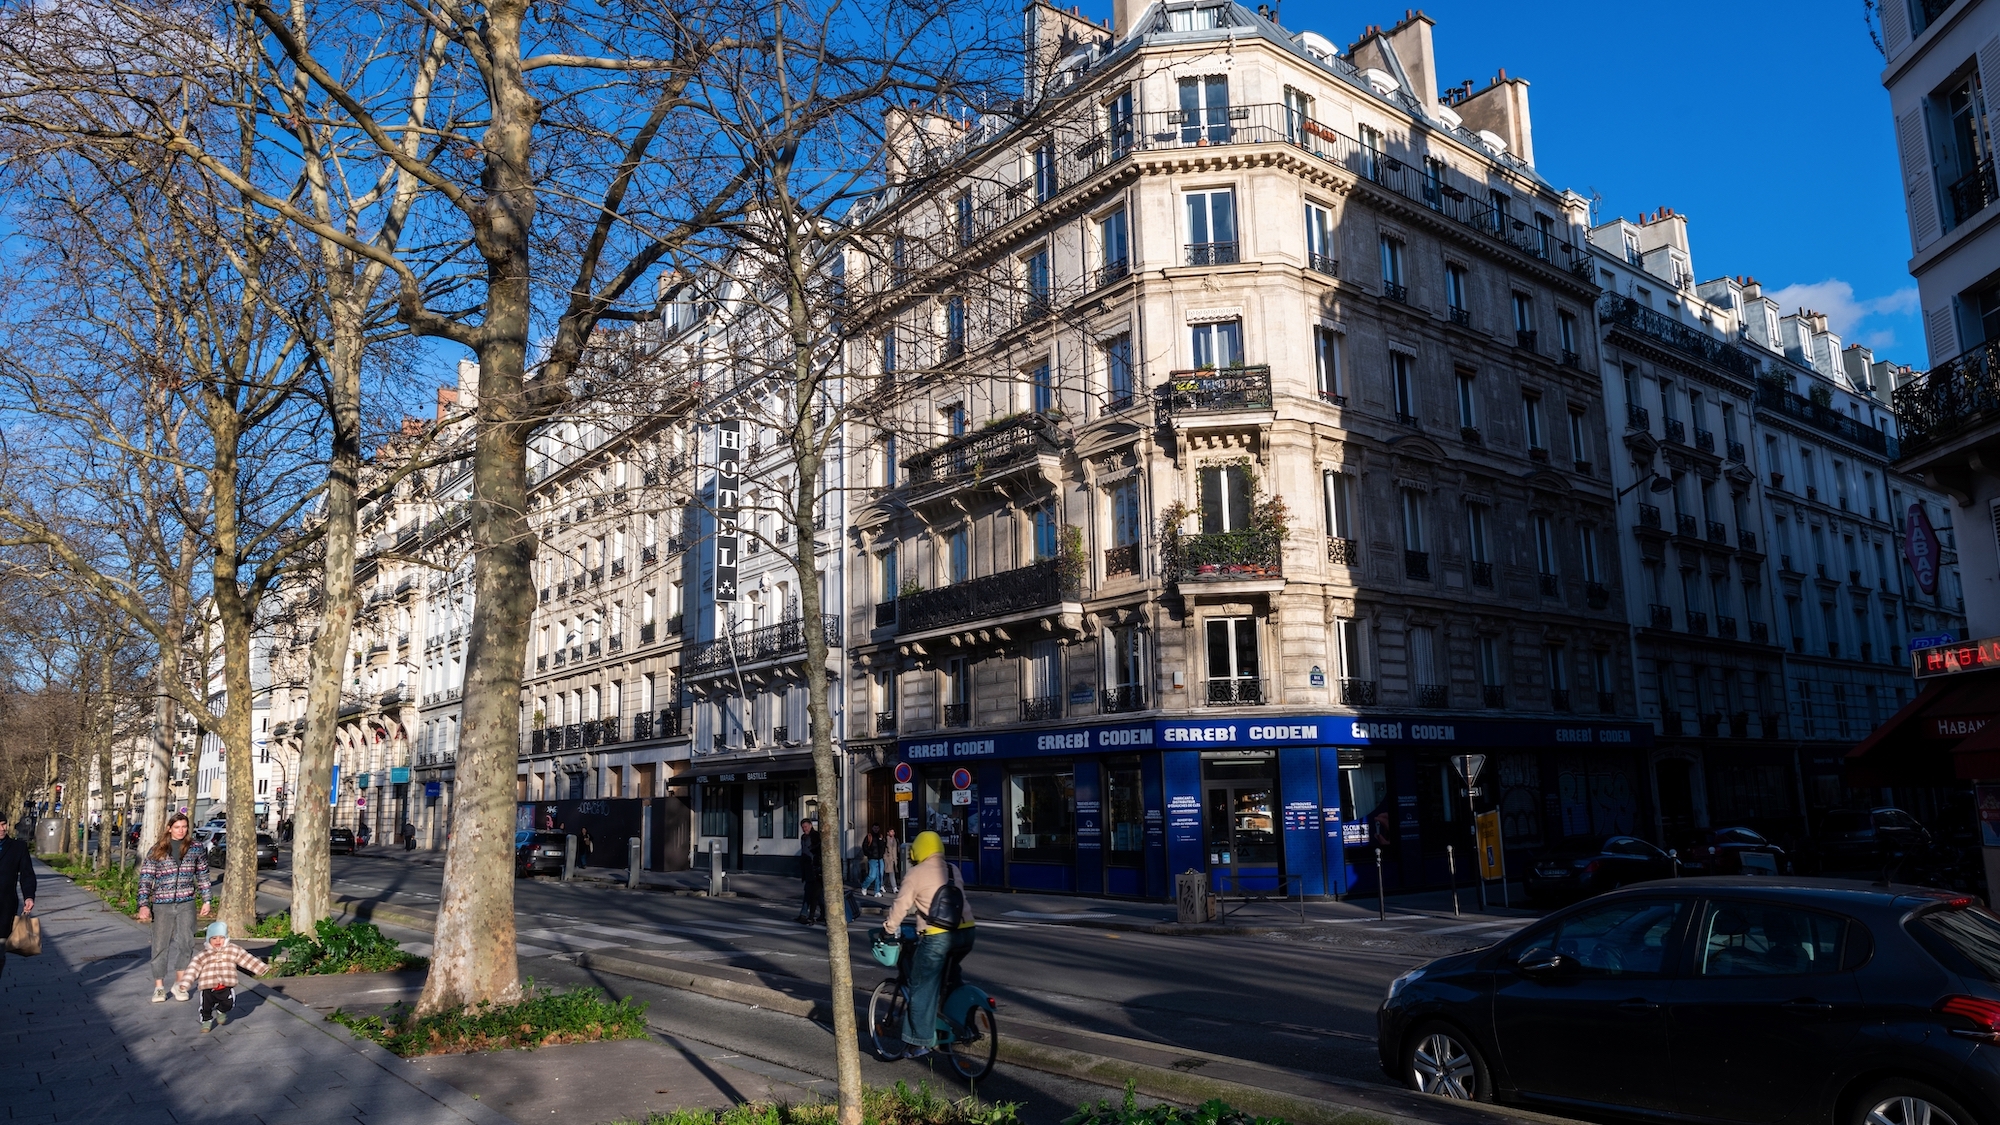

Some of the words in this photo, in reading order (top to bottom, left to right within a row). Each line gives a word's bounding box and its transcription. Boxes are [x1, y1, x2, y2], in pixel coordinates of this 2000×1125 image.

[718, 430, 739, 567] HOTEL
[1909, 512, 1933, 585] TABAC
[1099, 728, 1153, 747] CODEM
[1249, 725, 1318, 740] CODEM
[1411, 724, 1455, 740] CODEM
[1599, 729, 1631, 743] CODEM
[953, 739, 995, 756] CODEM
[696, 775, 709, 783] HOTEL
[719, 774, 735, 782] MARAIS
[747, 772, 767, 781] BASTILLE
